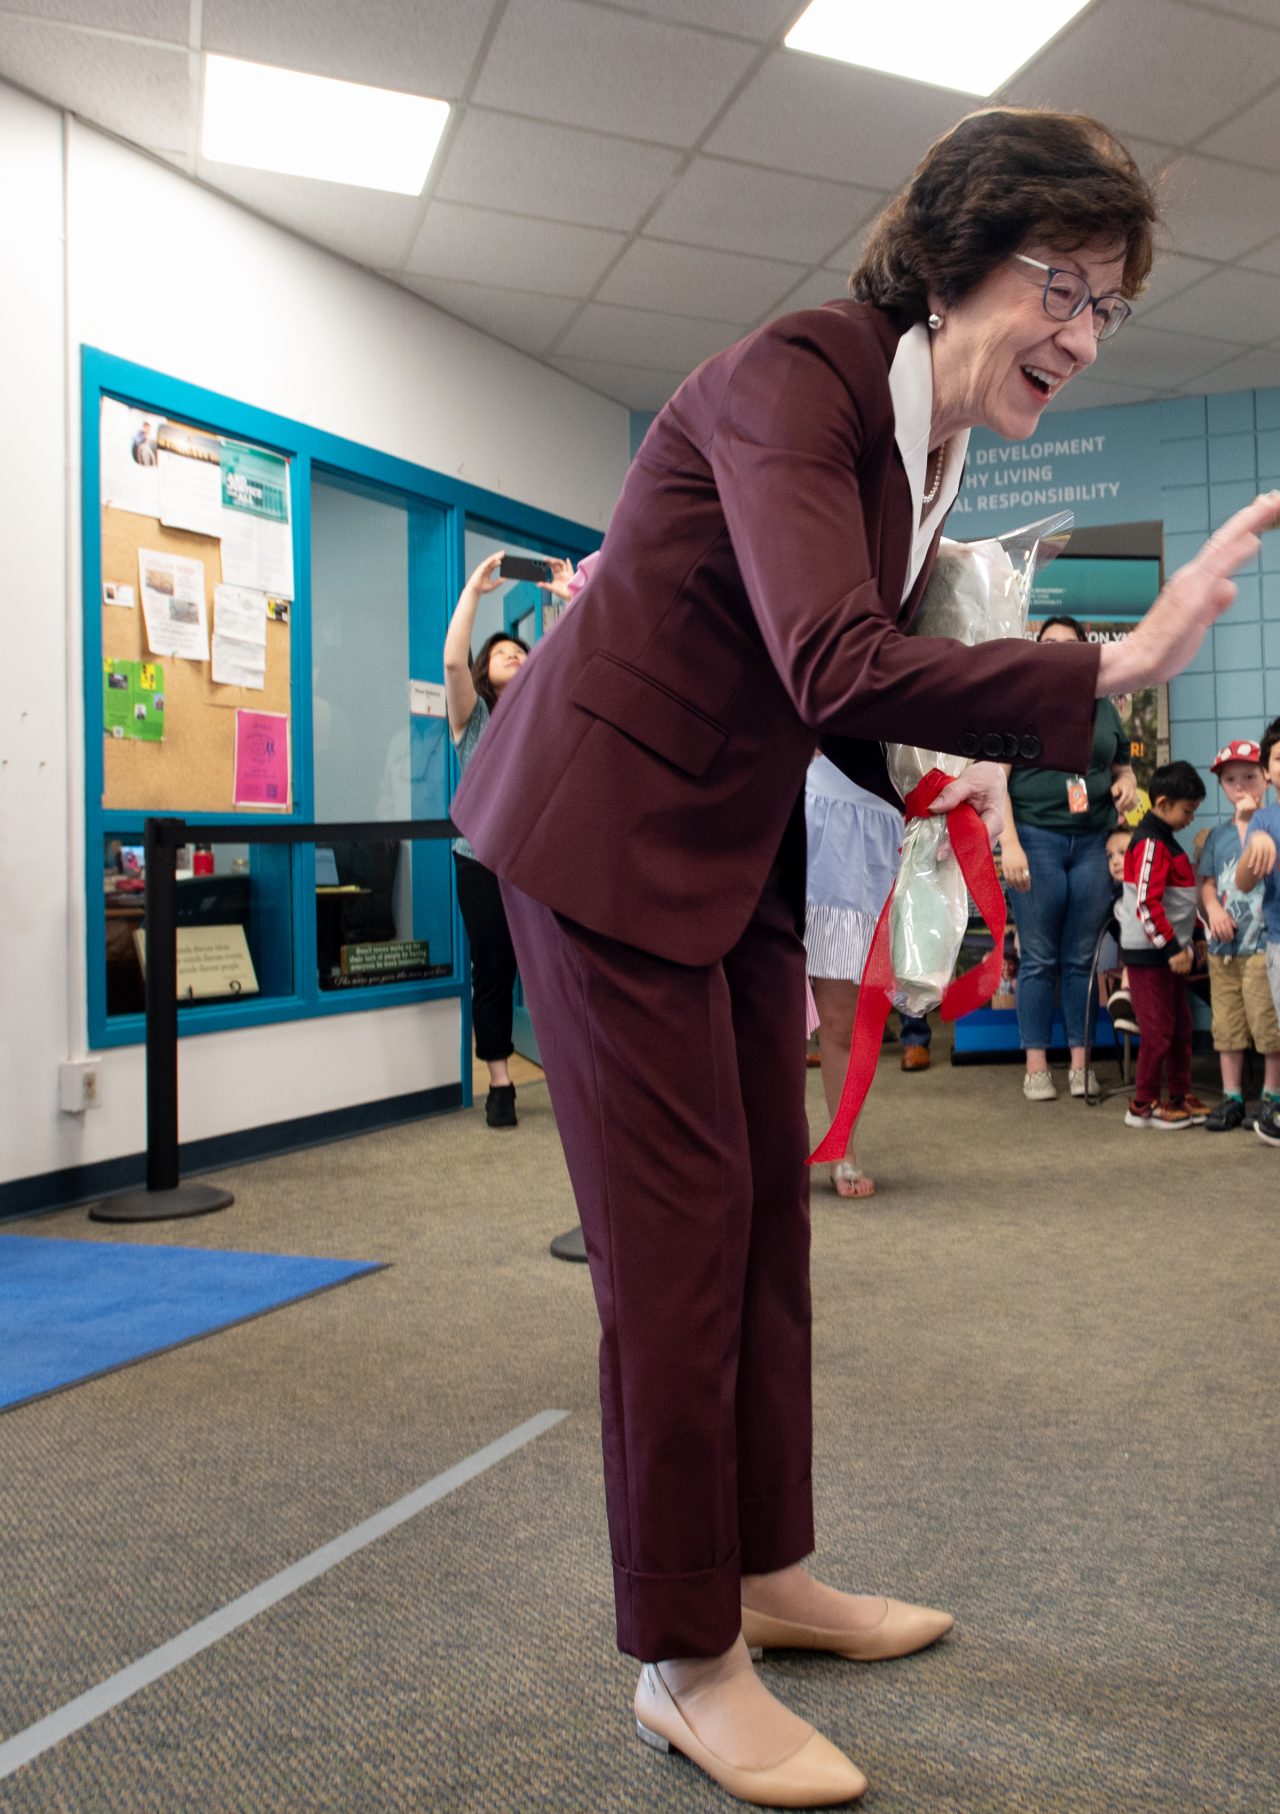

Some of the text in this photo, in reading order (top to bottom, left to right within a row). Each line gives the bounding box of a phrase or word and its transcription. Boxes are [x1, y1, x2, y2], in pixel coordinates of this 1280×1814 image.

[976, 436, 1106, 466] DEVELOPMENT
[994, 465, 1053, 486] LIVING
[977, 481, 1121, 511] RESPONSIBILITY
